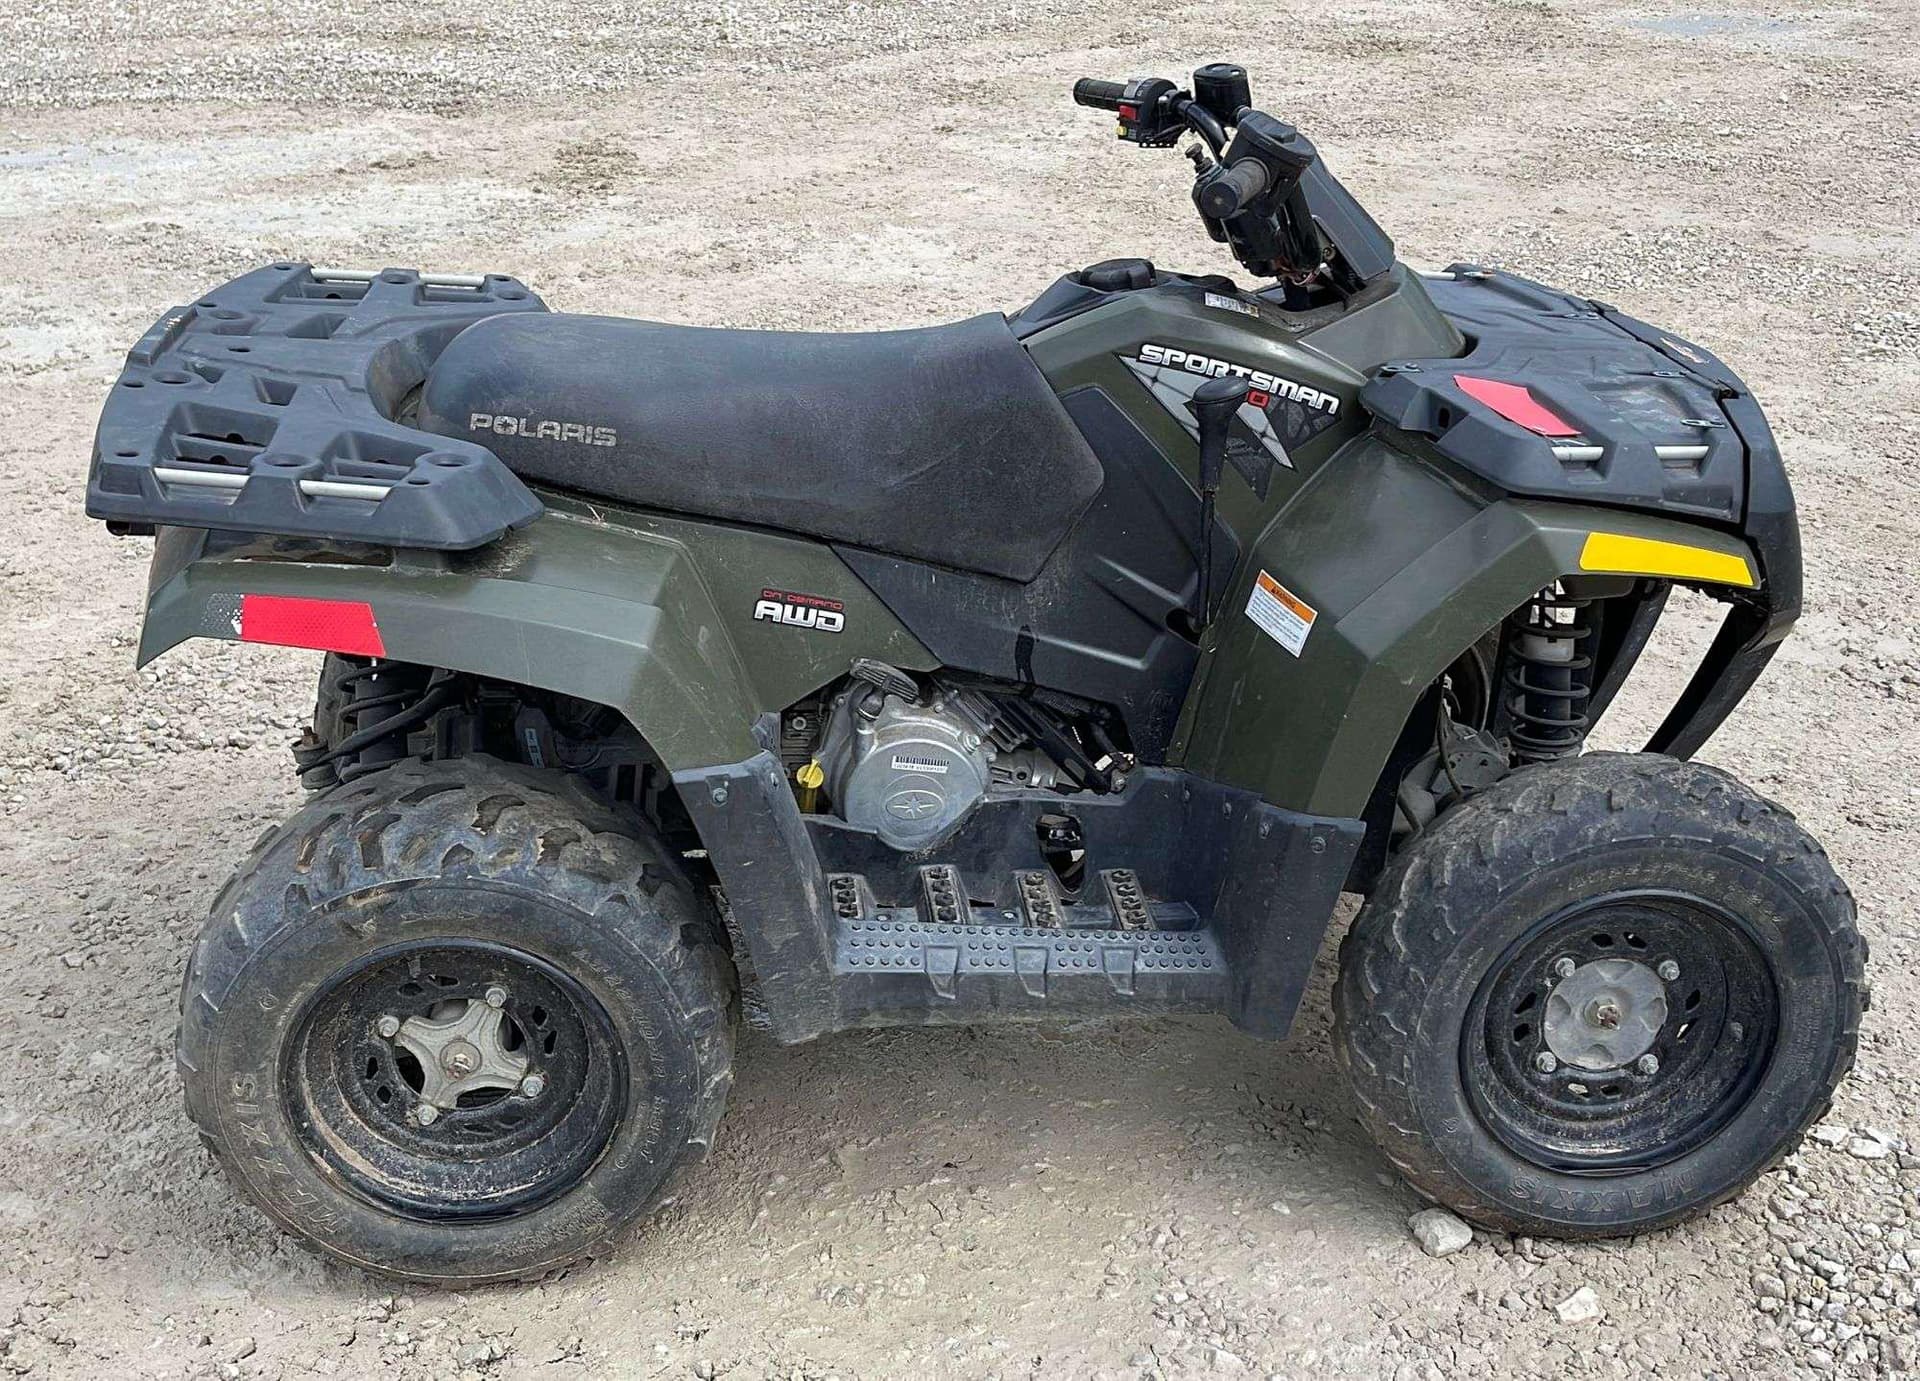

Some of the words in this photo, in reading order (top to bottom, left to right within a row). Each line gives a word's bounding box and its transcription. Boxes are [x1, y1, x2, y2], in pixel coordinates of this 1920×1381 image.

[1139, 343, 1340, 415] SPORTSMAN
[469, 412, 617, 447] POLARIS
[754, 600, 845, 632] AWD
